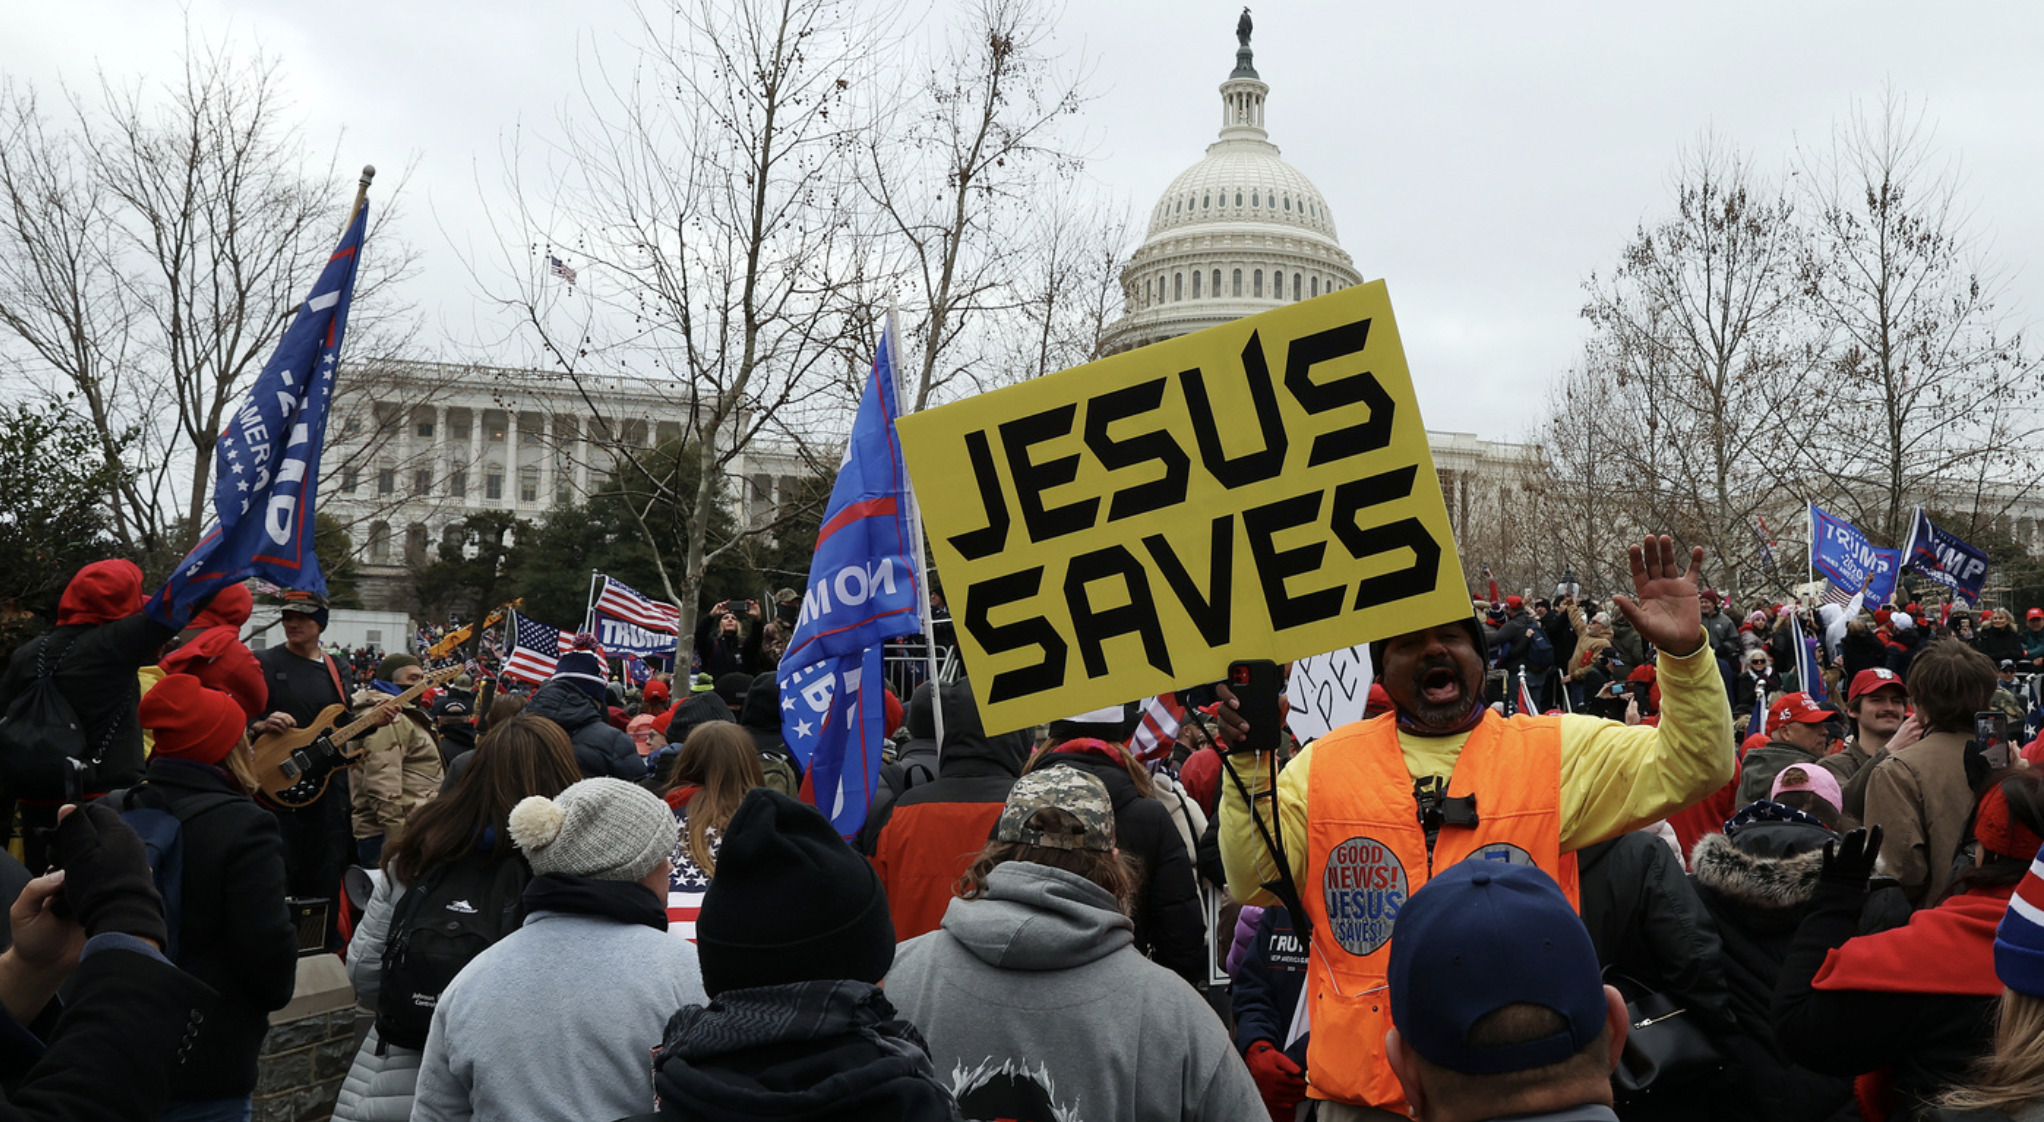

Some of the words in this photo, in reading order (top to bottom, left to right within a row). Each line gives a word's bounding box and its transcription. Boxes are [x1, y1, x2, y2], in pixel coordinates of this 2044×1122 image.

[947, 318, 1396, 562] JESUS
[1825, 523, 1890, 574] TRUMP
[965, 464, 1442, 706] SAVES
[1337, 845, 1383, 864] GOOD
[1328, 866, 1398, 889] NEWS!
[1330, 891, 1402, 920] JESUS
[1269, 935, 1303, 952] TRU
[1338, 921, 1383, 943] SAVES!
